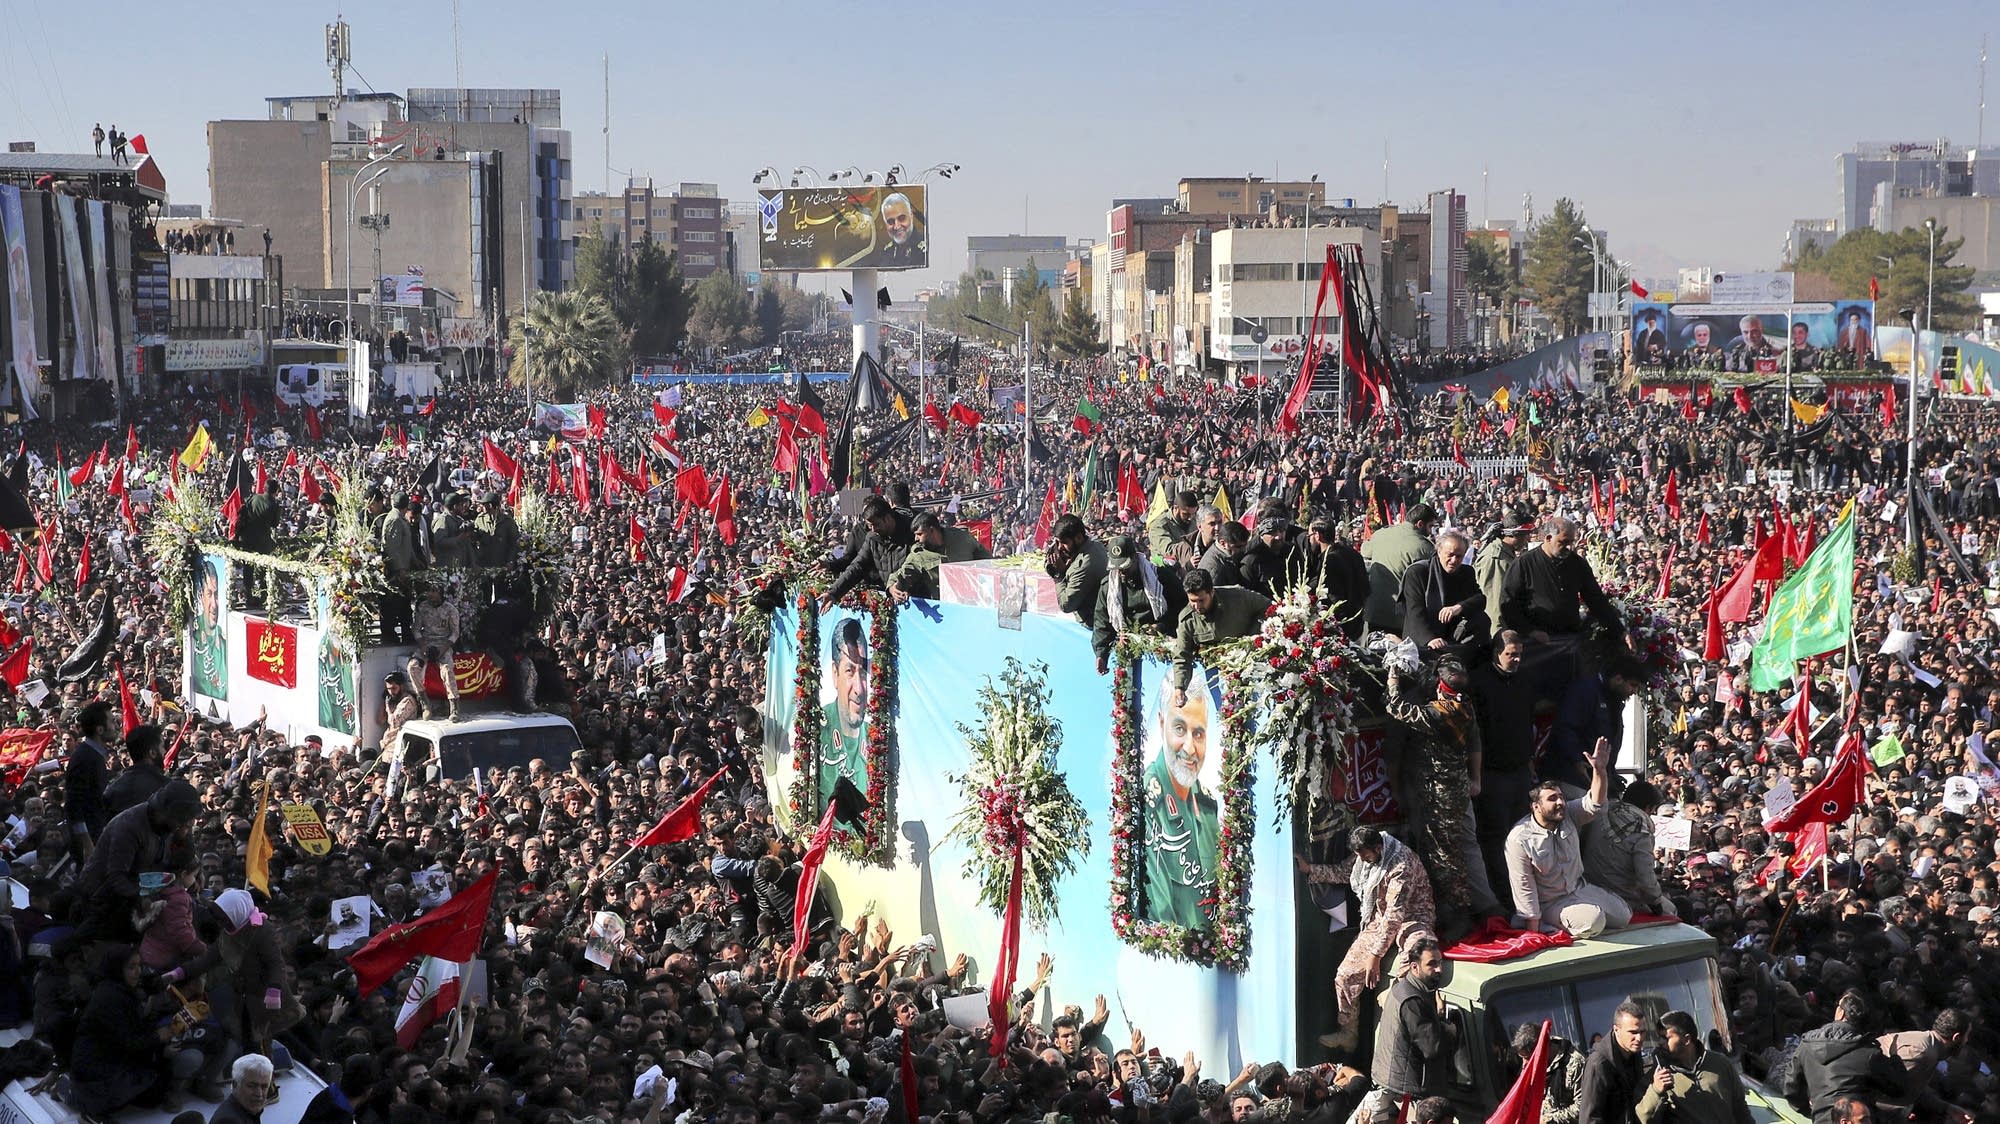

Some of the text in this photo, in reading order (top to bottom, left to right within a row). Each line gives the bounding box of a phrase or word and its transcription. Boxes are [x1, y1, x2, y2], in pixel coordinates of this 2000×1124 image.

[1890, 141, 1932, 153] رستوران
[297, 827, 325, 839] USA
[1145, 818, 1192, 846] سلیمانی
[1153, 838, 1192, 875] قاسم
[1182, 860, 1201, 886] حاج
